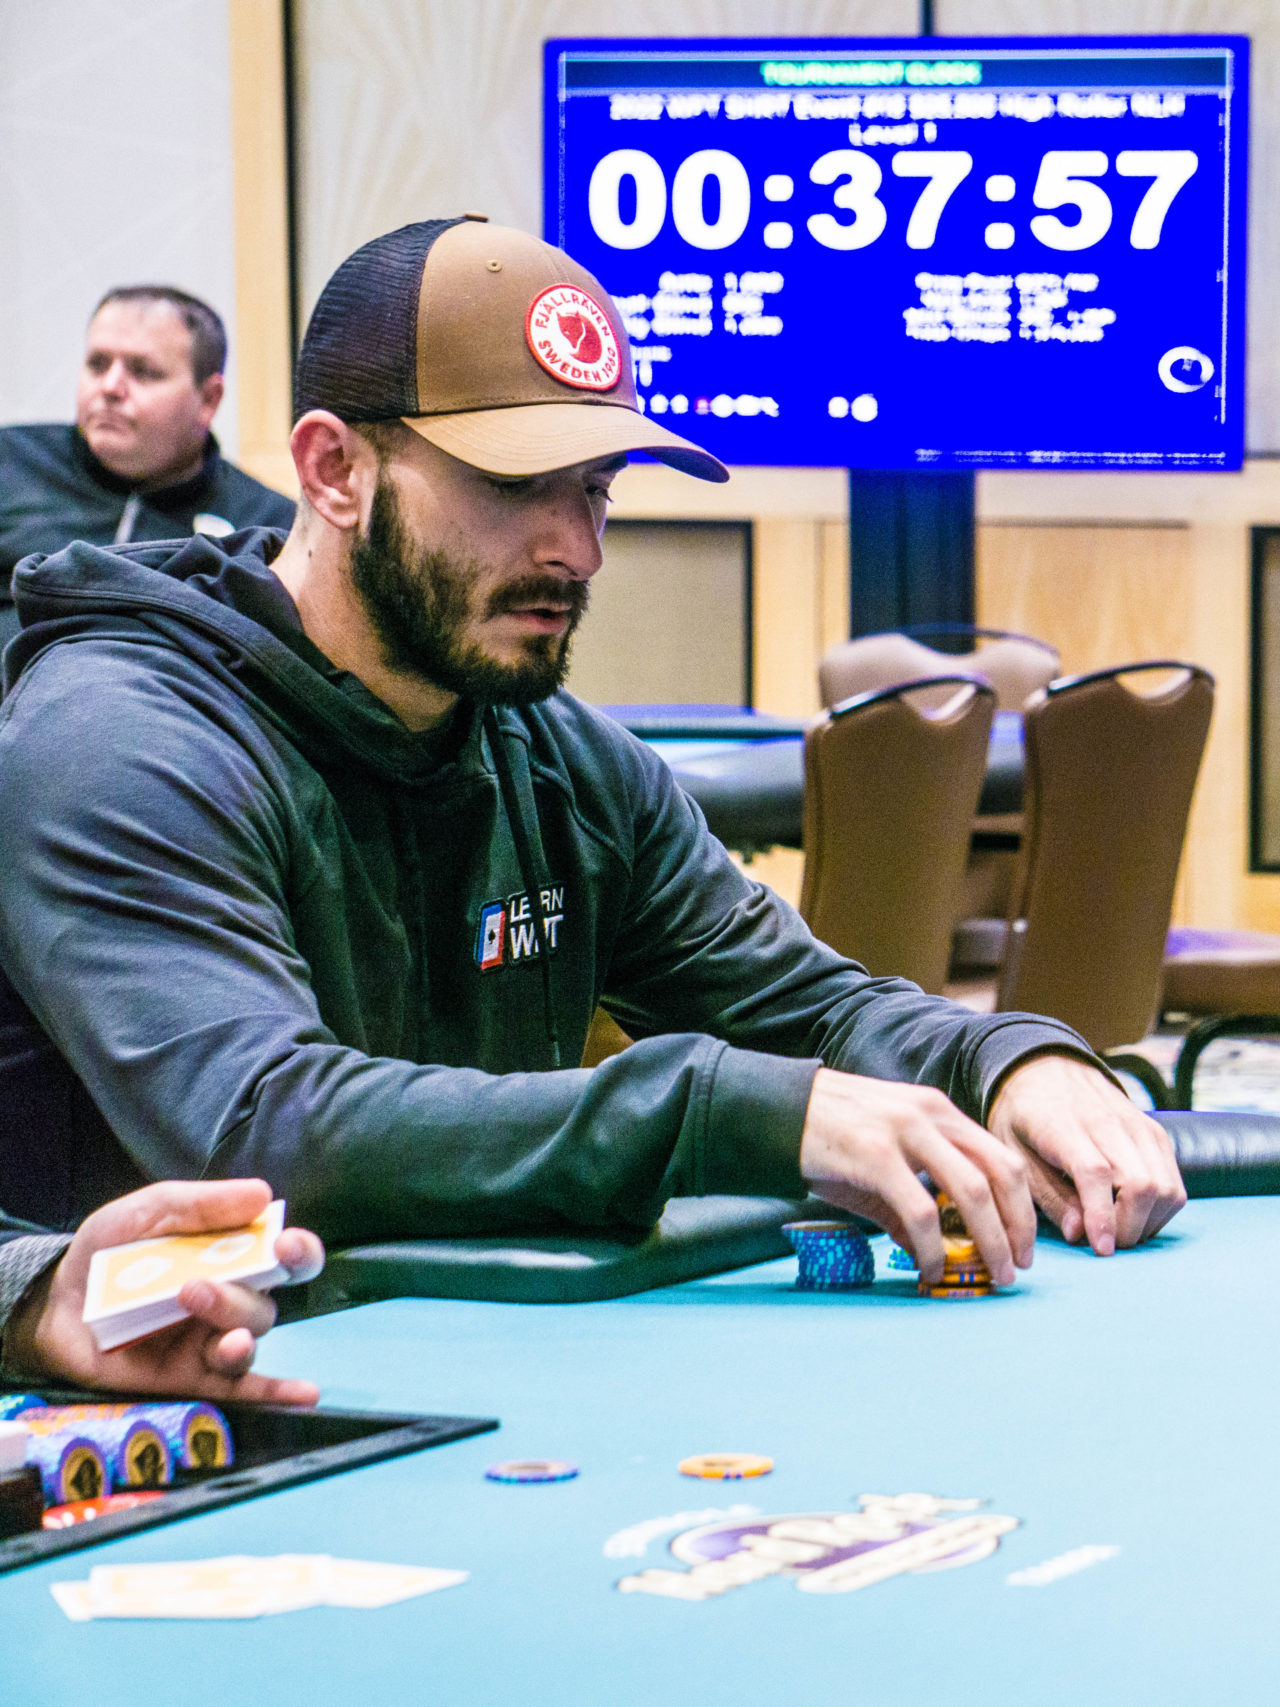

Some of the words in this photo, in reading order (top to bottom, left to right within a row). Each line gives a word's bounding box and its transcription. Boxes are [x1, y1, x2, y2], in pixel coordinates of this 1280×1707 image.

[905, 62, 981, 86] CLOCK
[588, 149, 1199, 251] 00:37:57
[538, 340, 602, 382] SWEDEN
[602, 346, 616, 378] 1960
[510, 887, 564, 924] LERN
